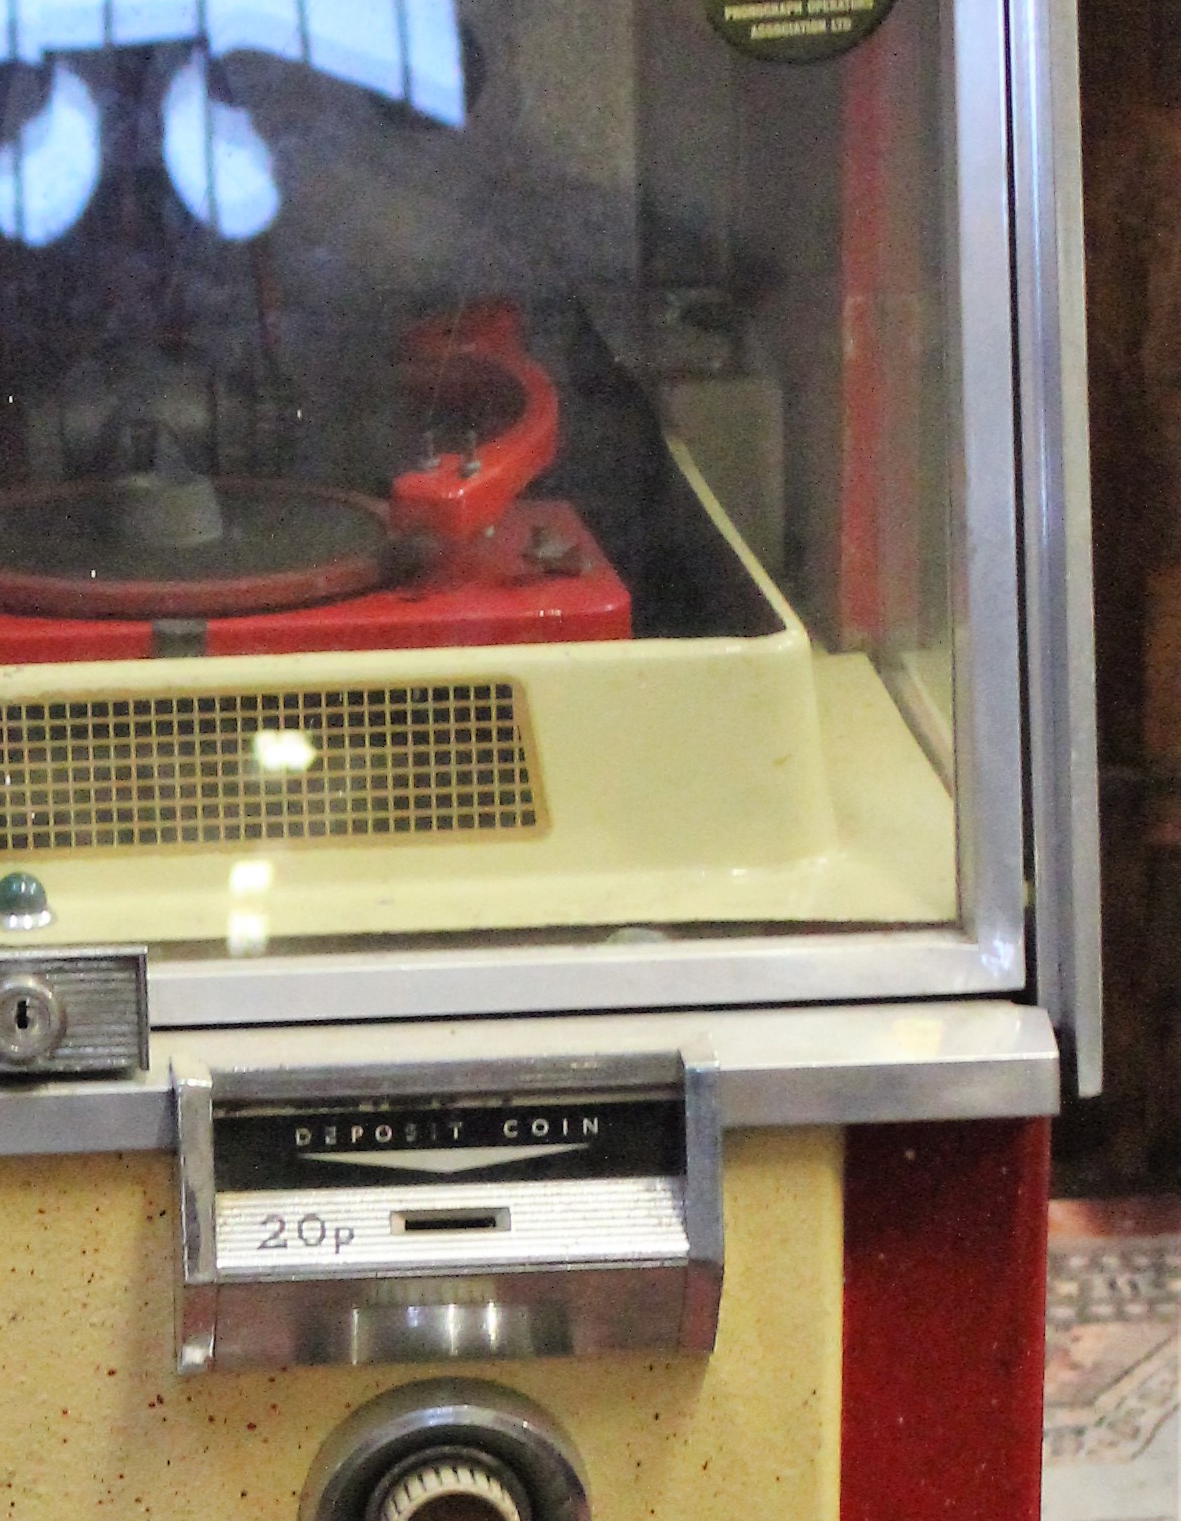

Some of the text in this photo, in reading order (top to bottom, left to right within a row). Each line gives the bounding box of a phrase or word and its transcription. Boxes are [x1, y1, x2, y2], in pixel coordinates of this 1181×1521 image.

[294, 1116, 601, 1147] DEPOSIT COIN
[256, 1211, 356, 1254] 20p
